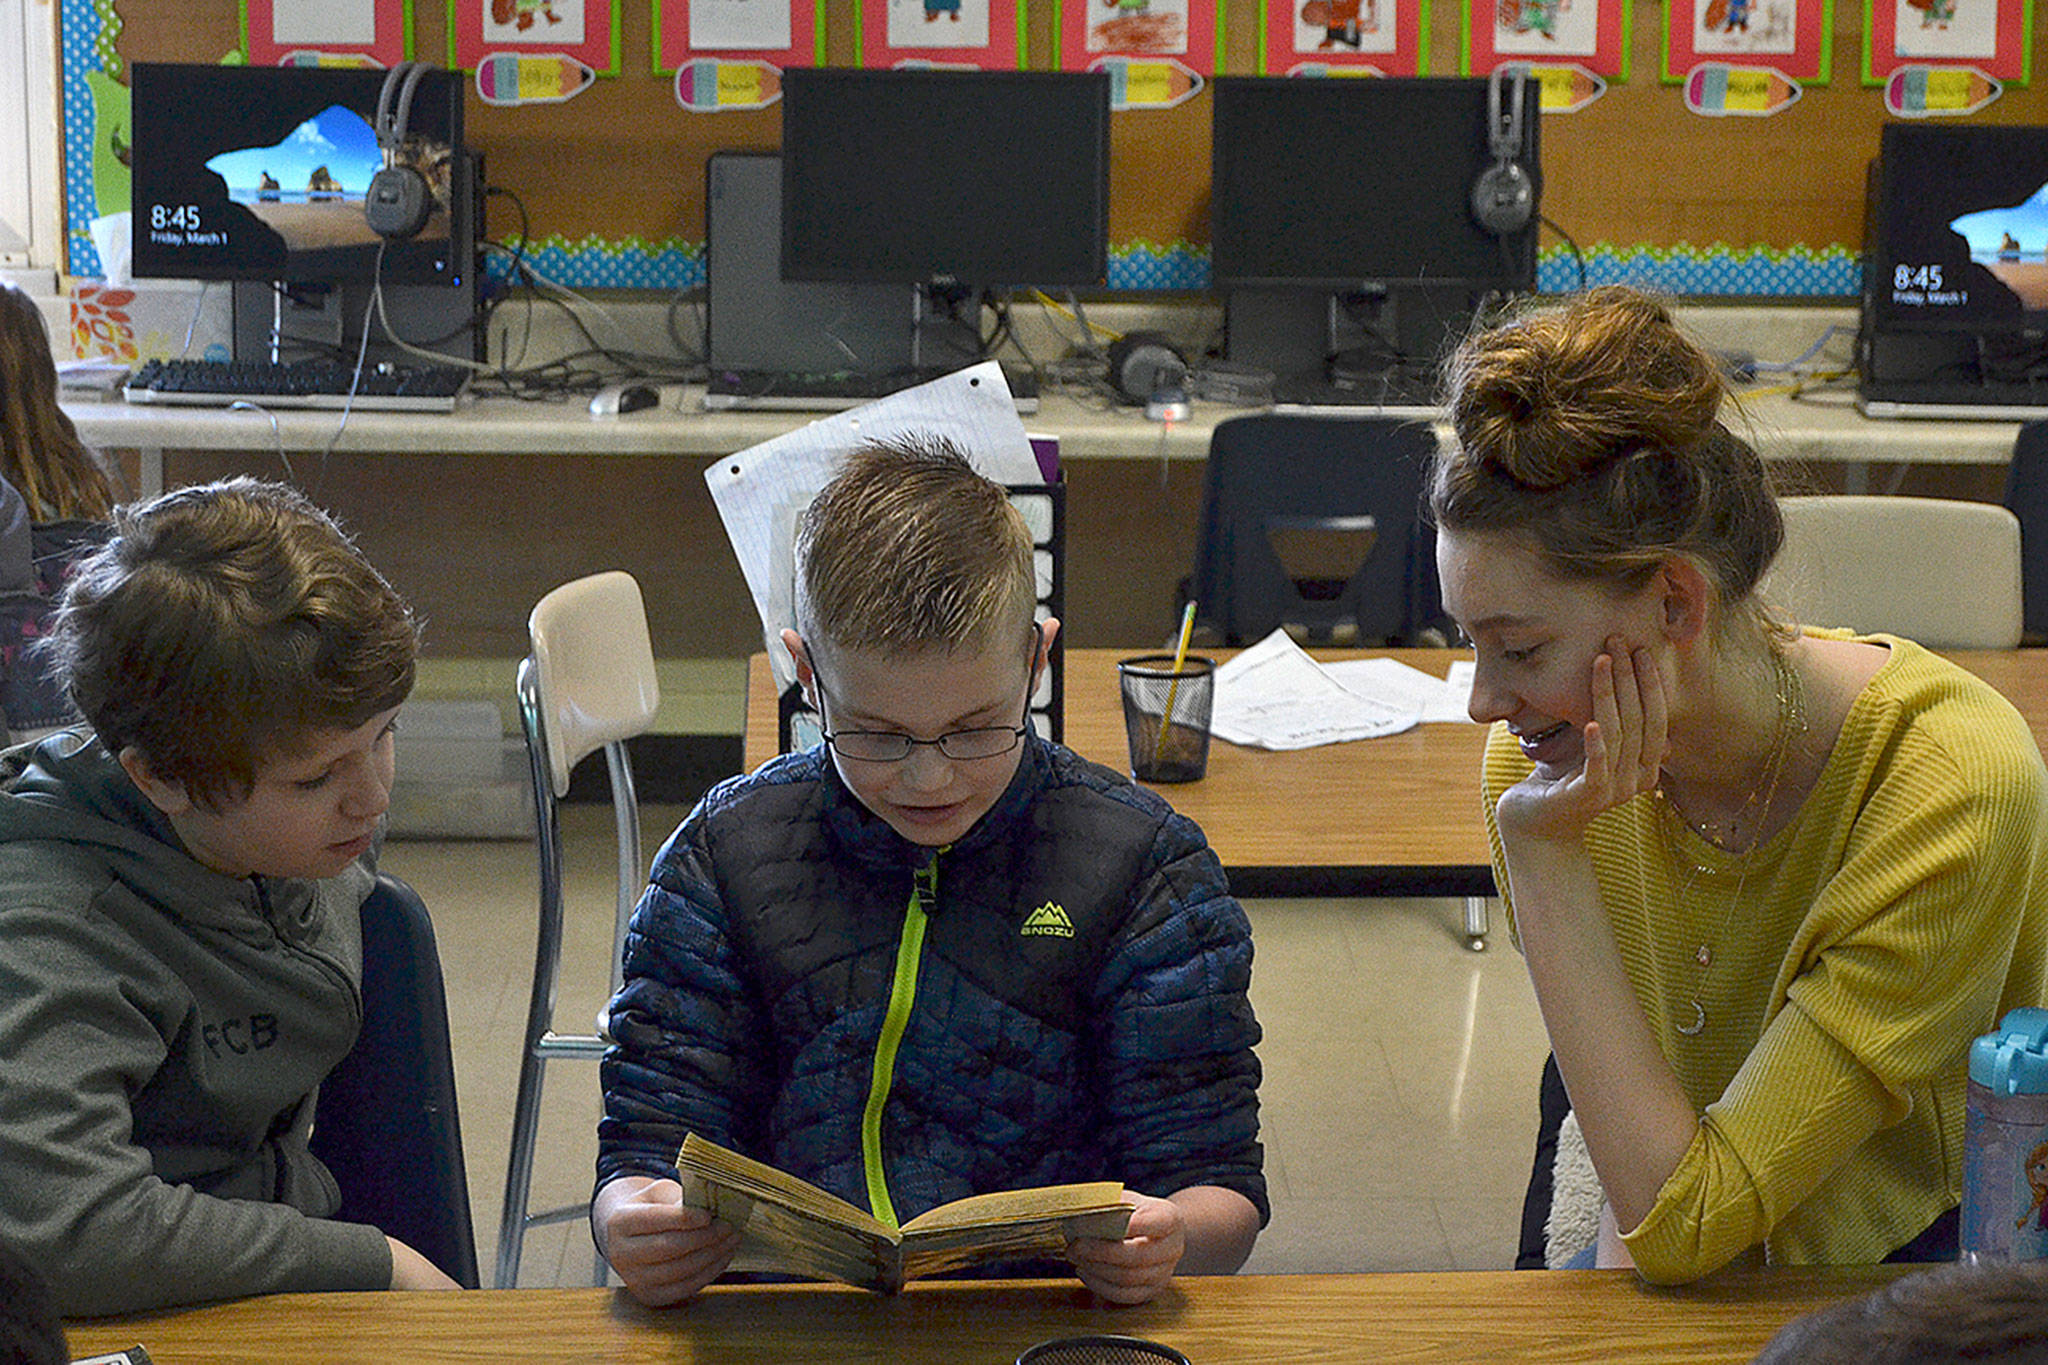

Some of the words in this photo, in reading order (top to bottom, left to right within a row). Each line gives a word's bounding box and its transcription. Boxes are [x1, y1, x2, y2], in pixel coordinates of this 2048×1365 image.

[151, 203, 201, 230] 8:45
[150, 231, 185, 247] Friday,
[186, 231, 220, 246] March
[221, 231, 228, 246] 1
[1894, 264, 1943, 290] 8:45
[1926, 290, 1960, 305] March
[202, 1013, 279, 1058] FCB
